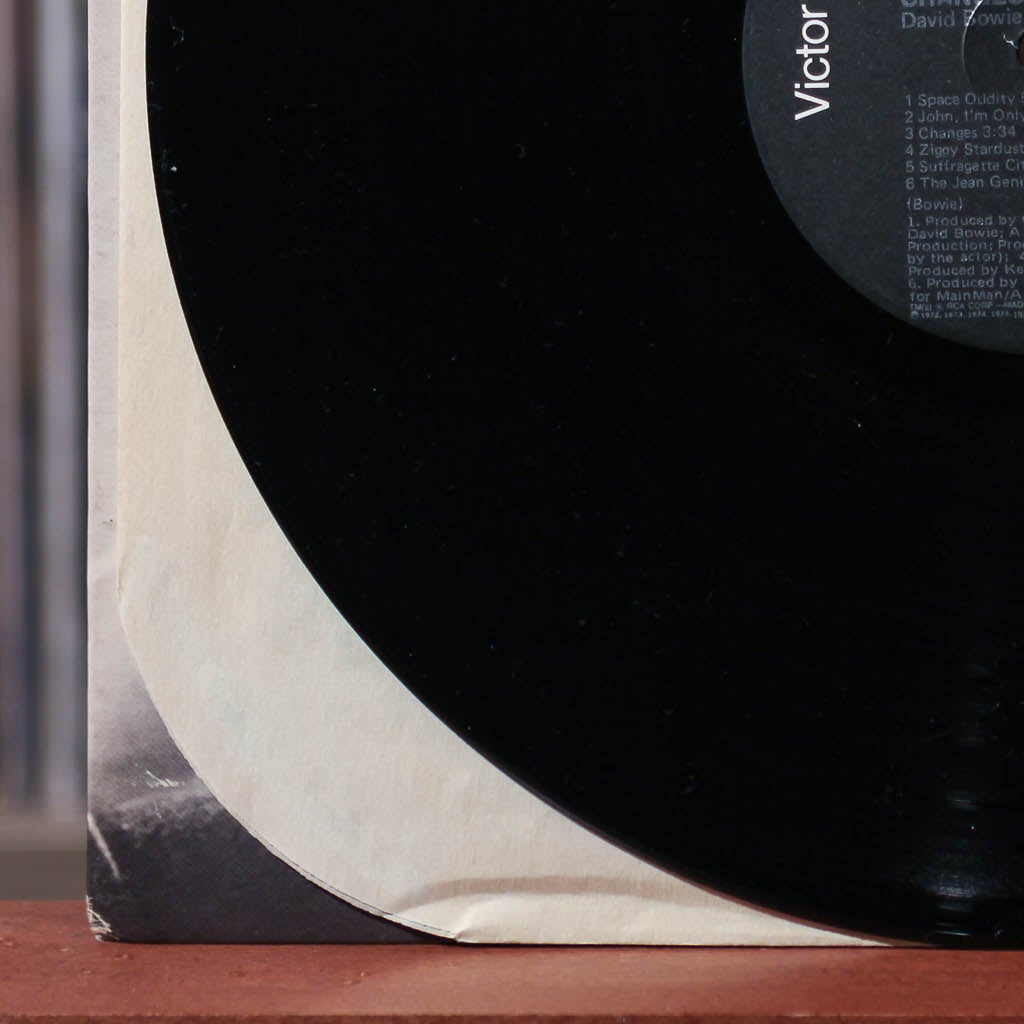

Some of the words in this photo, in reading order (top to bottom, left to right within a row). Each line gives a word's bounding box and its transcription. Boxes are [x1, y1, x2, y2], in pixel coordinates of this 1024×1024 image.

[901, 10, 956, 29] David
[963, 8, 1024, 27] Bowie
[795, 4, 831, 120] Victor
[905, 94, 912, 107] 1
[918, 94, 960, 108] Space
[965, 92, 1016, 107] Oddity
[905, 110, 914, 124] 2
[918, 110, 959, 124] John,
[964, 109, 989, 121] I'm
[905, 127, 914, 140] 3
[918, 126, 978, 141] Changes
[982, 125, 1017, 138] 3:34
[905, 144, 914, 156] 4
[919, 143, 959, 158] Ziggy
[964, 141, 1024, 155] Stardust
[905, 161, 915, 173] 5
[919, 158, 1000, 174] Suffragette
[905, 177, 915, 190] 6
[920, 176, 948, 189] The
[952, 175, 984, 189] Jean
[907, 197, 964, 212] (Bowie)
[907, 216, 920, 228] 1.
[926, 214, 993, 226] Produced
[998, 215, 1016, 227] by
[908, 229, 948, 240] David
[954, 228, 1004, 239] Bowie;
[1009, 227, 1020, 237] A
[908, 240, 993, 252] Production;
[907, 253, 924, 265] by
[931, 253, 953, 263] the
[908, 265, 975, 277] Produced
[981, 264, 998, 277] by
[907, 278, 921, 289] 6.
[926, 277, 994, 289] Produced
[1000, 276, 1018, 289] by
[910, 292, 931, 302] for
